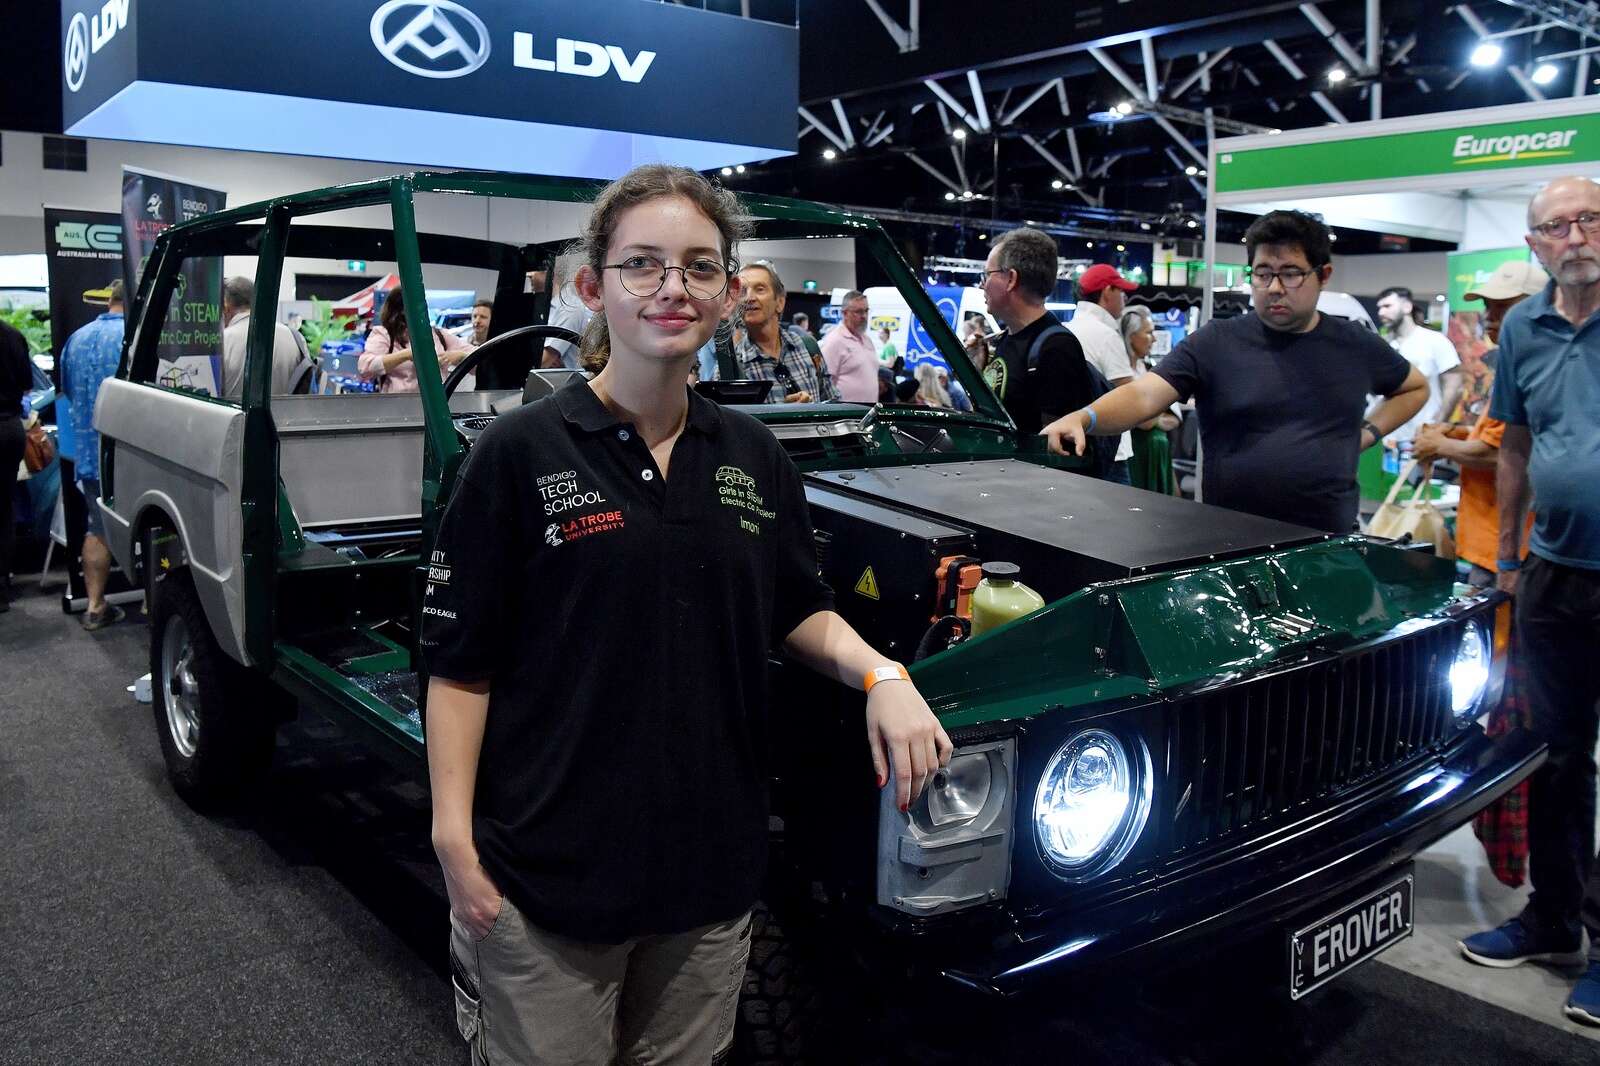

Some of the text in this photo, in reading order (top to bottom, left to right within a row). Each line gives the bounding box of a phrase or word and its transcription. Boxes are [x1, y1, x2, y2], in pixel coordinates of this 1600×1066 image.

[91, 0, 130, 54] LDV
[513, 31, 657, 84] LDV
[1453, 129, 1578, 160] Europcar
[182, 198, 208, 213] BENDIGO
[56, 250, 122, 260] AUSTRALIAN ELECTRI
[183, 303, 220, 323] STEAM
[159, 330, 174, 345] tric
[176, 329, 192, 345] Car
[536, 470, 577, 486] BENDIGO
[538, 480, 578, 501] TECH
[718, 485, 737, 496] Girls
[544, 490, 606, 516] SCHOOL
[720, 496, 746, 508] Electric
[561, 511, 623, 533] LA TROBE
[565, 521, 625, 541] UNIVERSITY
[740, 515, 760, 535] Imani
[428, 566, 451, 582] RSHIP
[437, 608, 457, 619] EAGLE
[1313, 891, 1403, 978] EROVER
